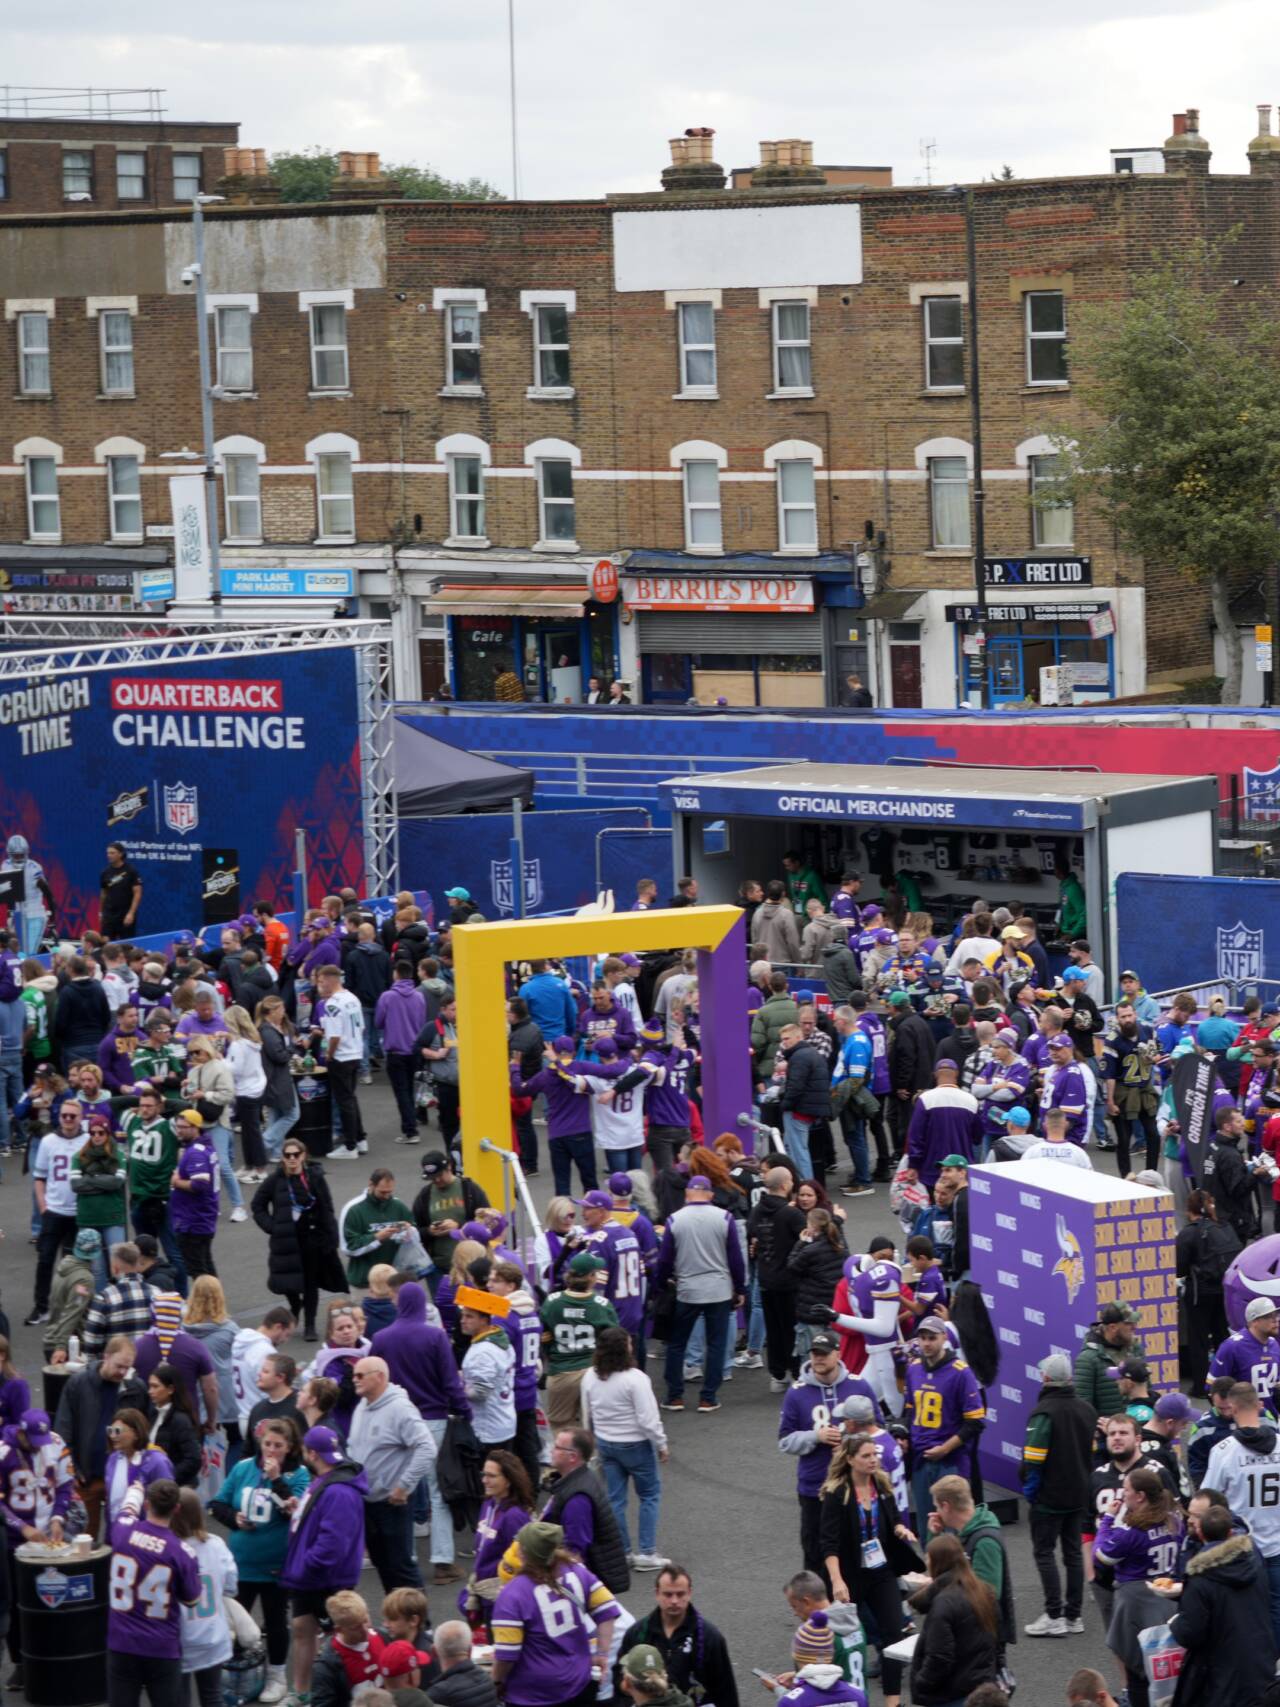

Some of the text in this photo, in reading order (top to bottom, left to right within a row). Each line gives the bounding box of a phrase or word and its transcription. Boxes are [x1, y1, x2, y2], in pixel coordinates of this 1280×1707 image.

[97, 575, 127, 587] STUDIOS
[236, 572, 290, 582] PARK LANE
[1026, 563, 1056, 582] FRET
[1059, 563, 1082, 581] LTD
[232, 583, 295, 592] MINI MARKET
[636, 577, 742, 600] BERRIES
[750, 578, 797, 600] POP
[988, 607, 1009, 620] FRET
[1011, 607, 1026, 620] LTD
[472, 630, 503, 642] Cafe
[0, 677, 90, 725] CRUNCH
[115, 683, 278, 708] QUARTERBACK
[18, 715, 73, 756] TIME
[113, 714, 305, 749] CHALLENGE
[169, 804, 194, 825] NFL
[672, 797, 700, 809] VISA
[778, 796, 956, 819] OFFICIAL MERCHANDISE
[936, 846, 949, 869] 8
[498, 879, 537, 903] NL
[1223, 951, 1258, 978] NFL
[1195, 1061, 1211, 1091] TIME
[1184, 1088, 1196, 1106] IT'S
[1187, 1090, 1207, 1144] CRUNCH
[132, 1129, 161, 1162] 20
[1041, 1147, 1073, 1159] TAYLOR
[617, 1250, 640, 1298] 18
[563, 1307, 586, 1319] WHITE
[521, 1333, 540, 1368] 18
[554, 1323, 596, 1354] 92
[1250, 1362, 1279, 1399] 64
[913, 1389, 943, 1429] 18
[1247, 1473, 1280, 1508] 16
[129, 1530, 166, 1553] MOSS
[1147, 1541, 1178, 1576] 30
[109, 1553, 173, 1619] 84
